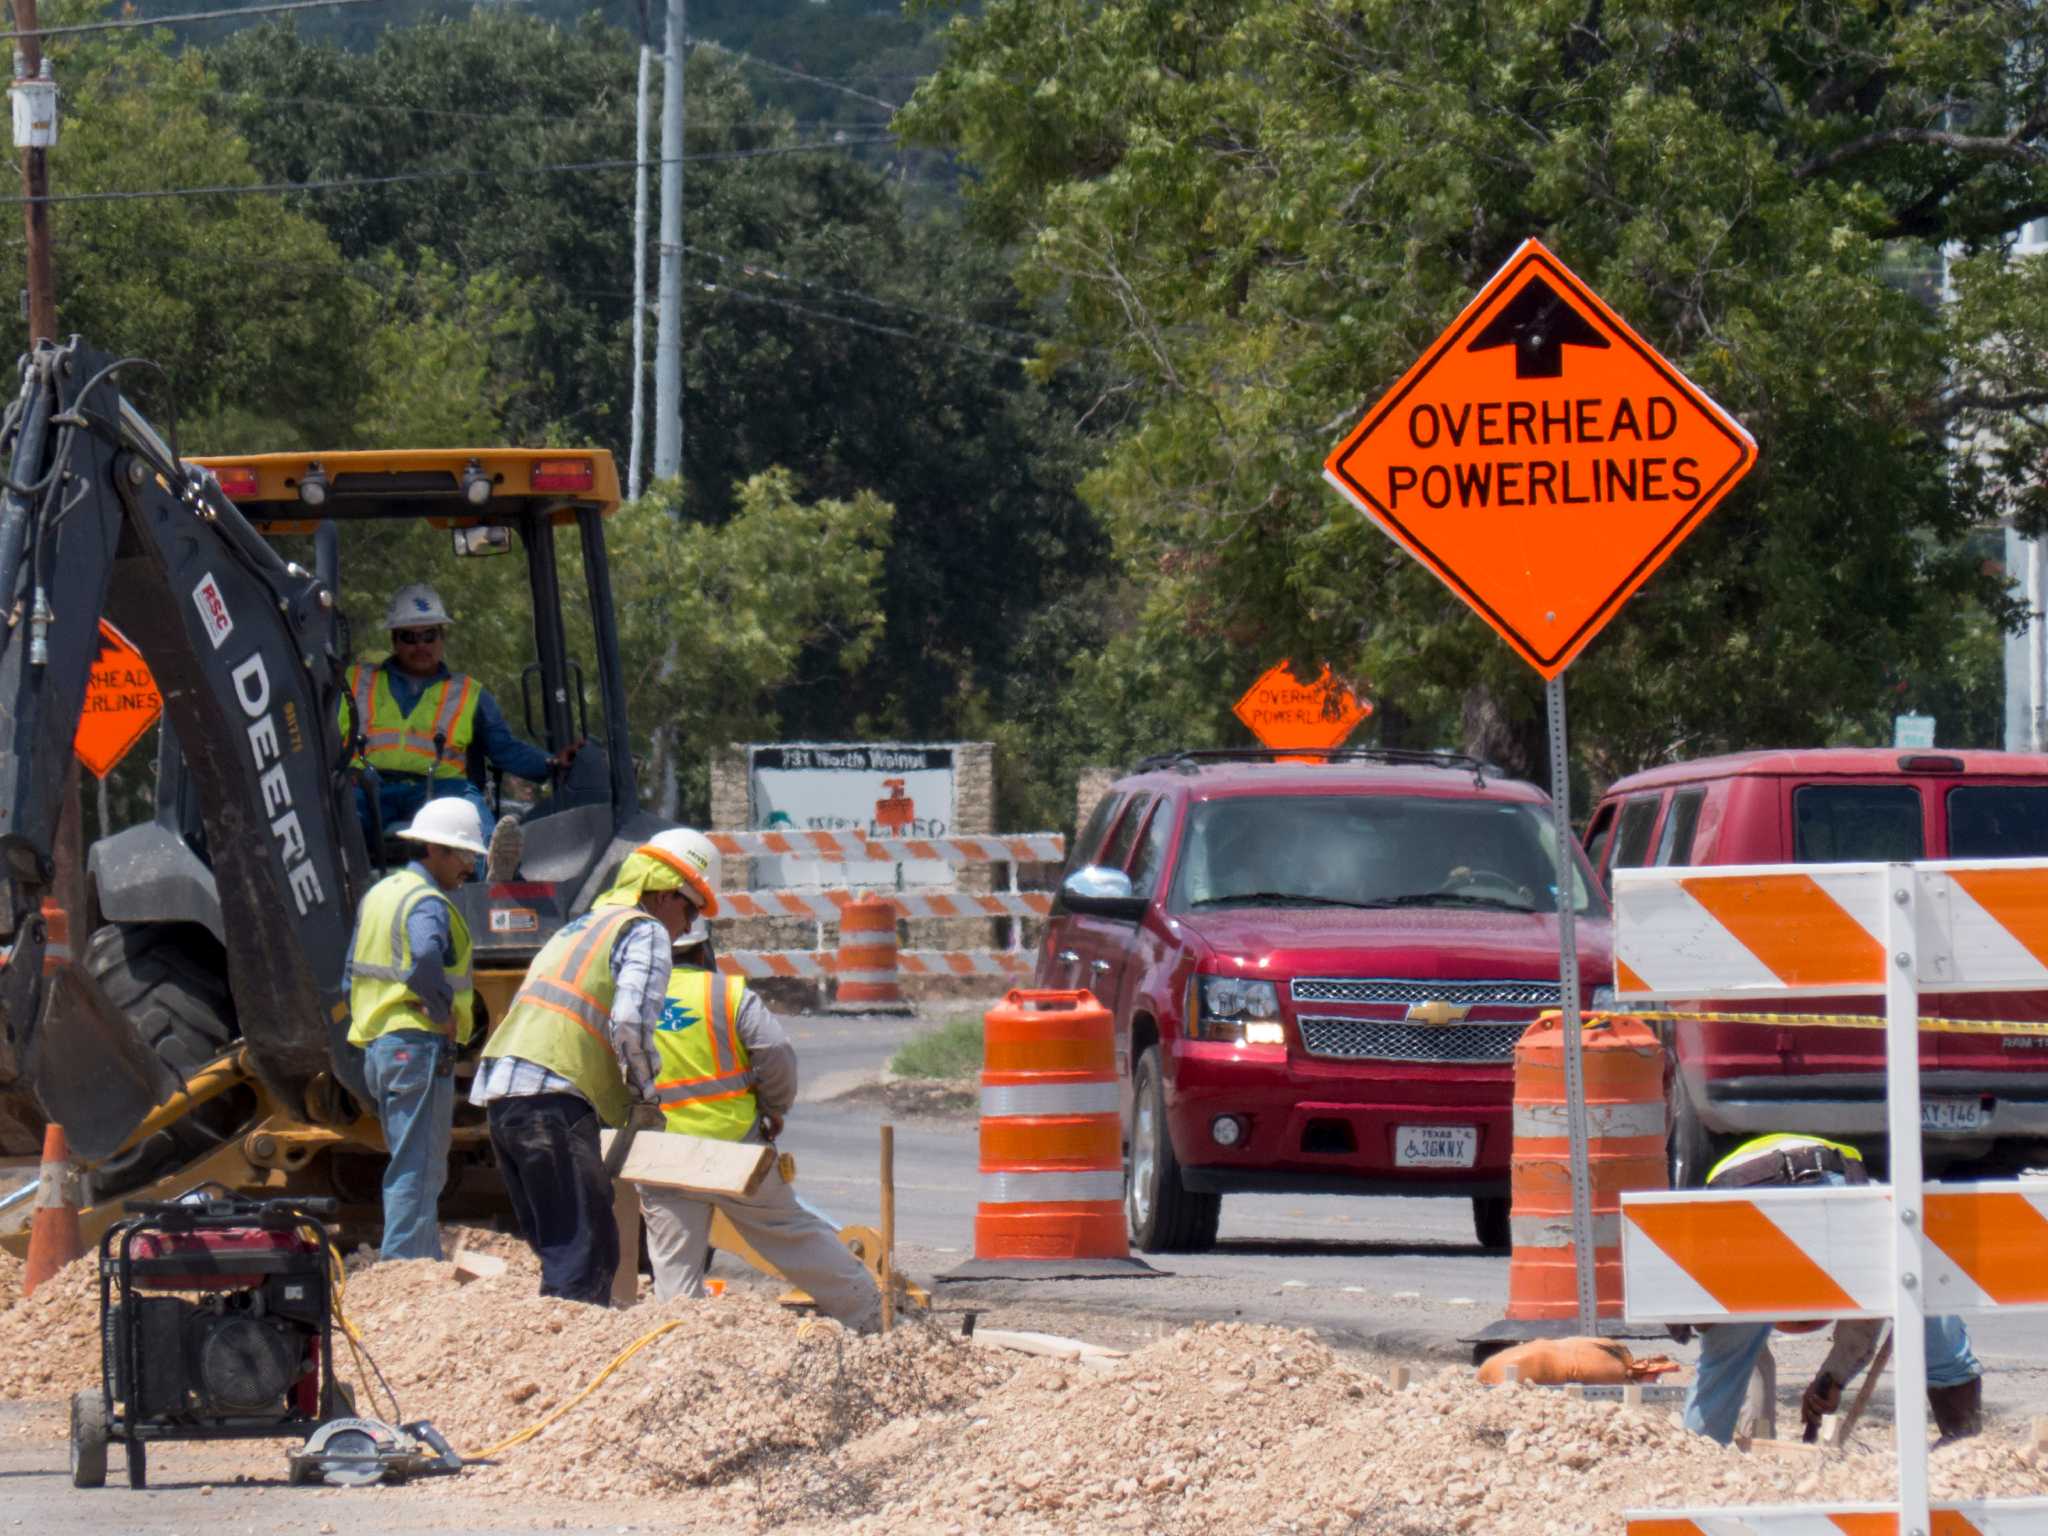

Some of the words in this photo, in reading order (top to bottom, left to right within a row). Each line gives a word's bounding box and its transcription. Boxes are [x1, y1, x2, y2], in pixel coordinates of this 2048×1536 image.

[1408, 396, 1678, 449] OVERHEAD
[1387, 456, 1702, 510] POWERLINES
[202, 583, 229, 631] RSC
[231, 652, 326, 917] DEERE
[1421, 1129, 1452, 1138] TEXAS
